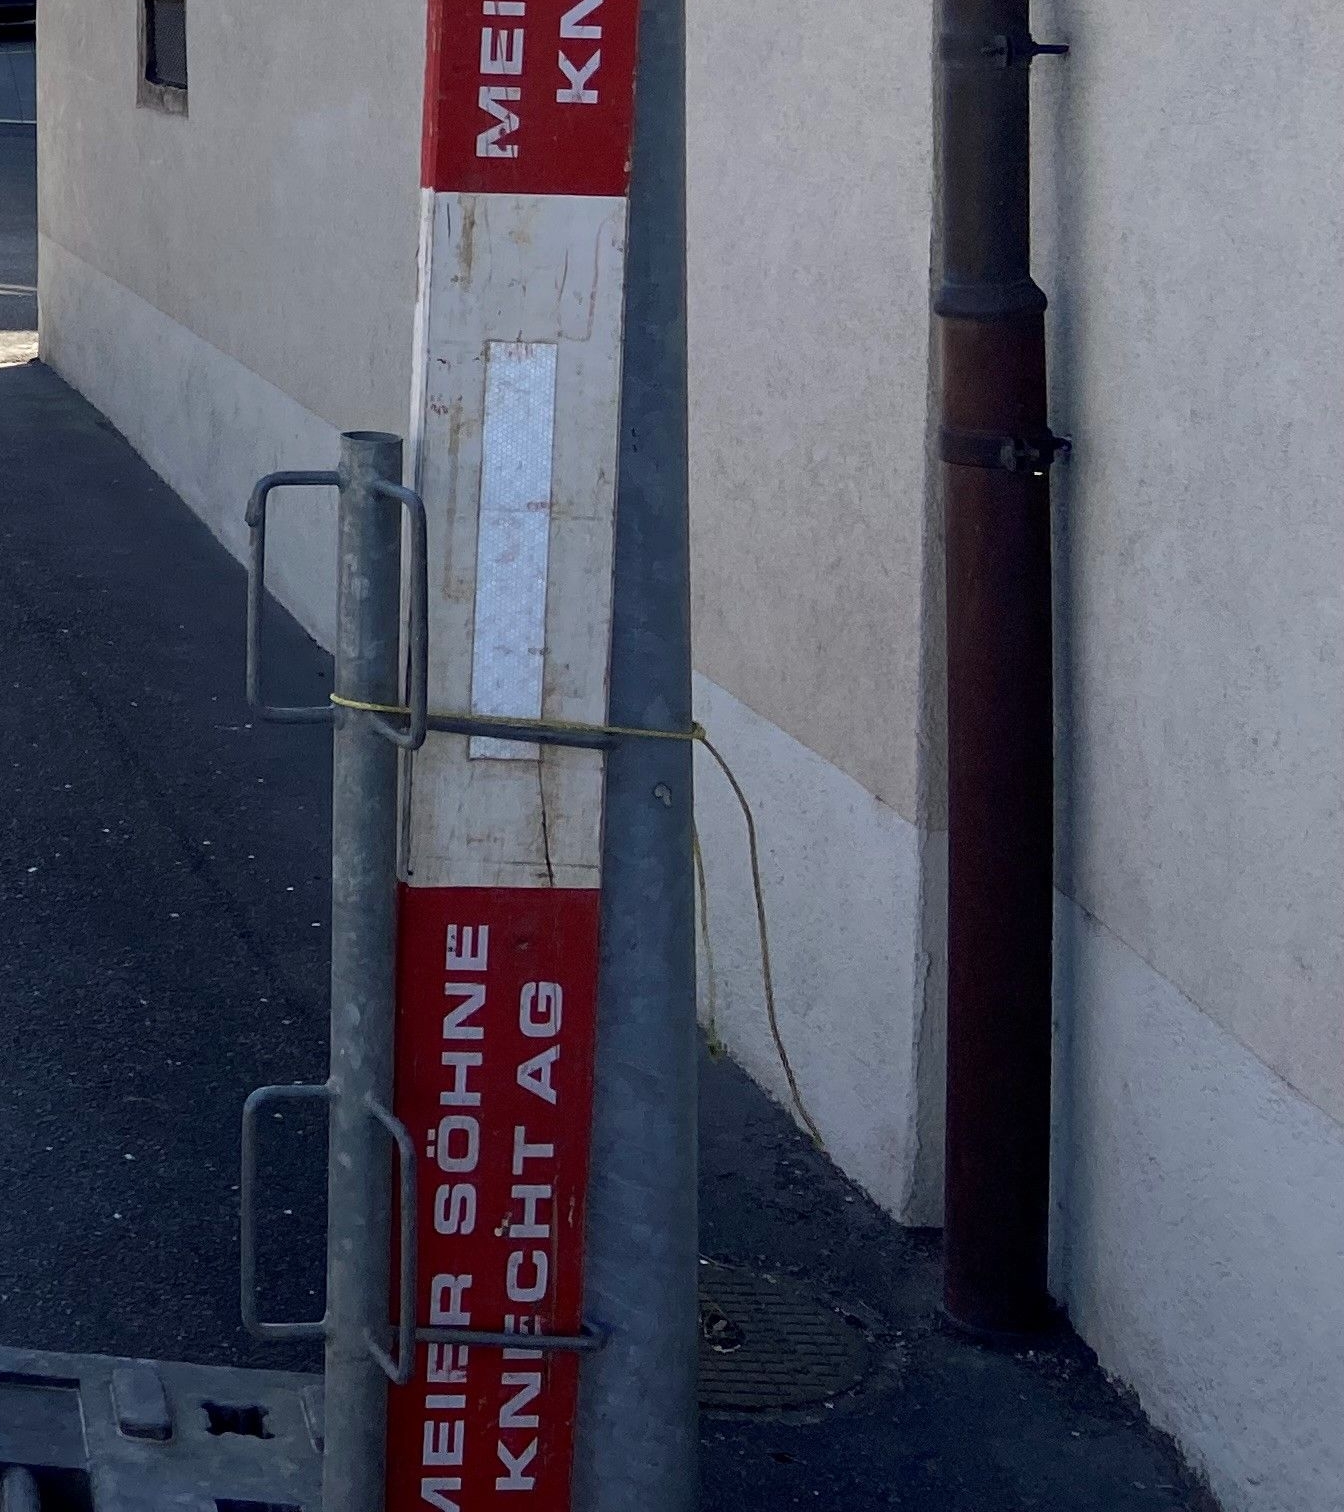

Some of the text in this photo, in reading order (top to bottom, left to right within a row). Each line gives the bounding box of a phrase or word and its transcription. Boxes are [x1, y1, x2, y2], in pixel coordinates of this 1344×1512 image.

[426, 923, 490, 1235] SÖHNE
[495, 981, 563, 1491] KNECHT AG
